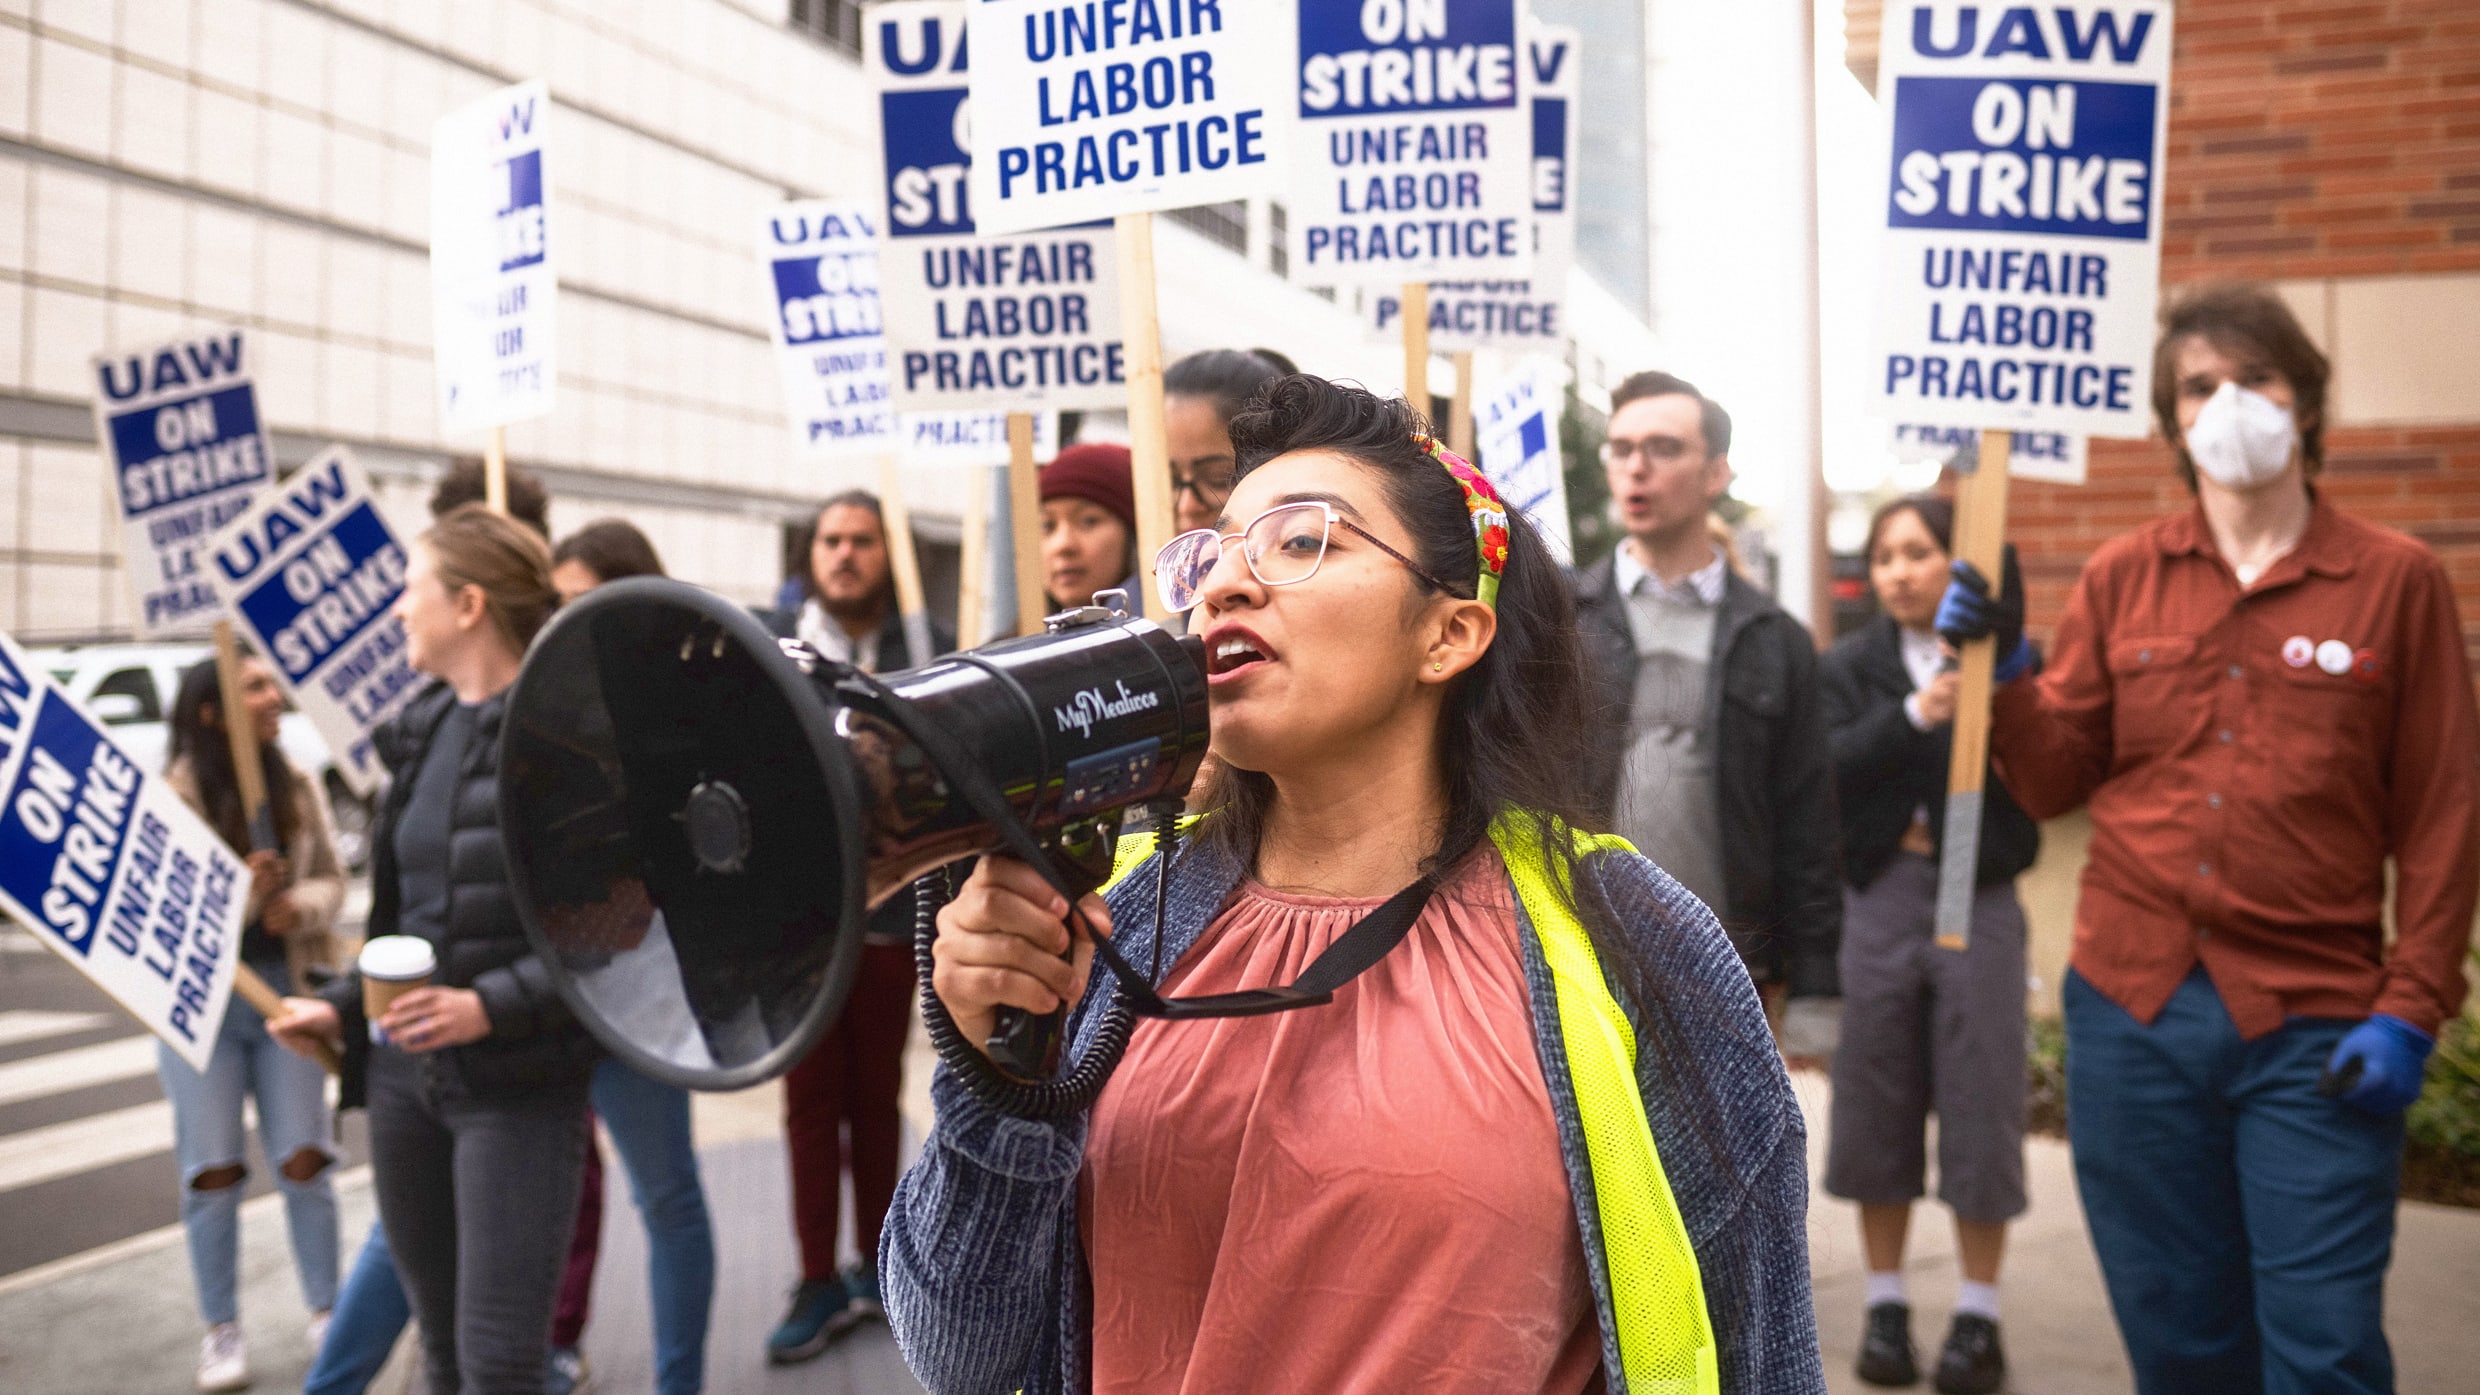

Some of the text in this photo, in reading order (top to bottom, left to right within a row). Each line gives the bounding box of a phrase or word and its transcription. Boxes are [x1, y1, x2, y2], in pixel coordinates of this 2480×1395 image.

[1025, 0, 1222, 63] UNFAIR
[1360, 0, 1447, 44] ON
[1912, 7, 2155, 64] UAW
[1038, 51, 1215, 127] LABOR
[1302, 44, 1513, 110] STRIKE
[1330, 123, 1488, 166] UNFAIR
[1971, 82, 2076, 149] ON
[998, 109, 1266, 199] PRACTICE
[1896, 150, 2148, 224] STRIKE
[1338, 172, 1480, 213] LABOR
[924, 241, 1095, 289] UNFAIR
[1307, 218, 1517, 264] PRACTICE
[1924, 248, 2108, 298] UNFAIR
[936, 294, 1088, 340] LABOR
[1376, 297, 1557, 336] PACTICE
[1929, 302, 2093, 351] LABOR
[102, 332, 242, 400] UAW
[904, 343, 1126, 392] PRACTICE
[1886, 355, 2134, 412] PRACTICE
[155, 396, 218, 453] ON
[123, 432, 267, 512] STRIKE
[214, 460, 348, 582] UAW
[282, 532, 352, 605] ON
[273, 543, 408, 675] STRIKE
[15, 747, 78, 844] ON
[42, 740, 137, 942] STRIKE
[106, 811, 170, 957] UNFAIR
[145, 850, 199, 983] LABOR
[168, 850, 236, 1043] PRACTICE
